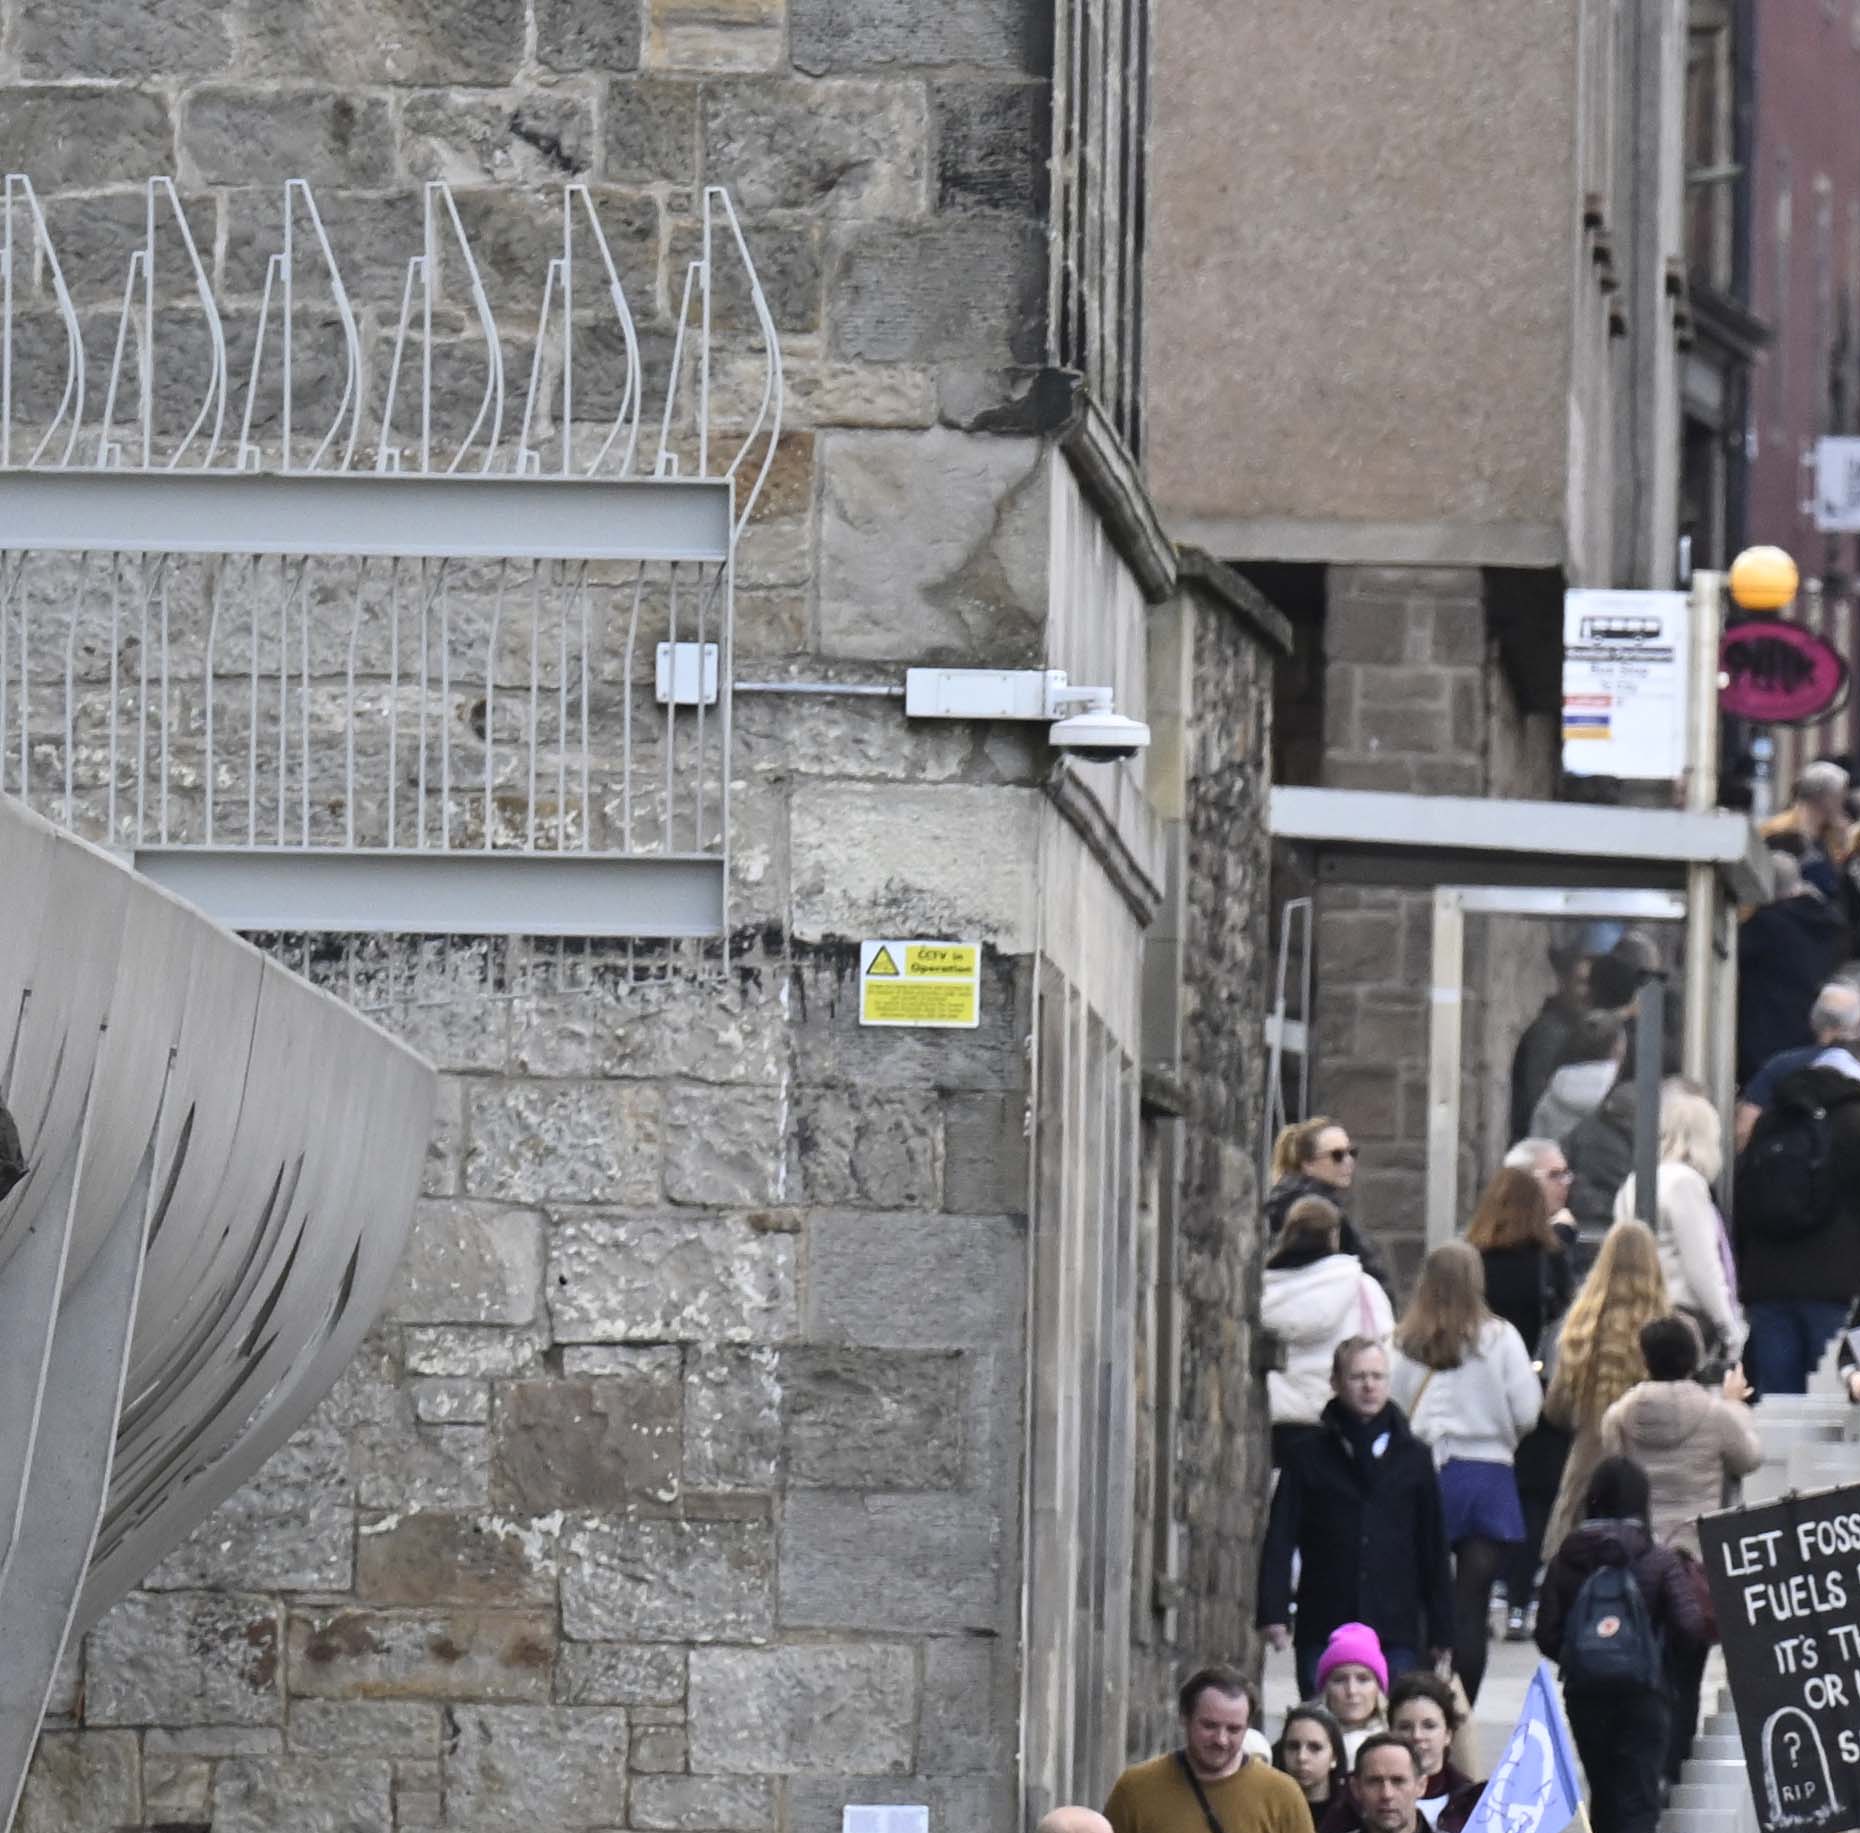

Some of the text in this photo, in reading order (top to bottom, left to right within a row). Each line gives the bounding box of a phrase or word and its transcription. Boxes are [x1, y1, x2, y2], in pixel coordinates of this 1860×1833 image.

[911, 963, 972, 974] Operation
[1721, 1530, 1784, 1578] LET
[1743, 1571, 1848, 1627] FUELS
[1774, 1635, 1818, 1676] IT'S
[1803, 1674, 1849, 1711] OR
[1782, 1781, 1817, 1801] RIP
